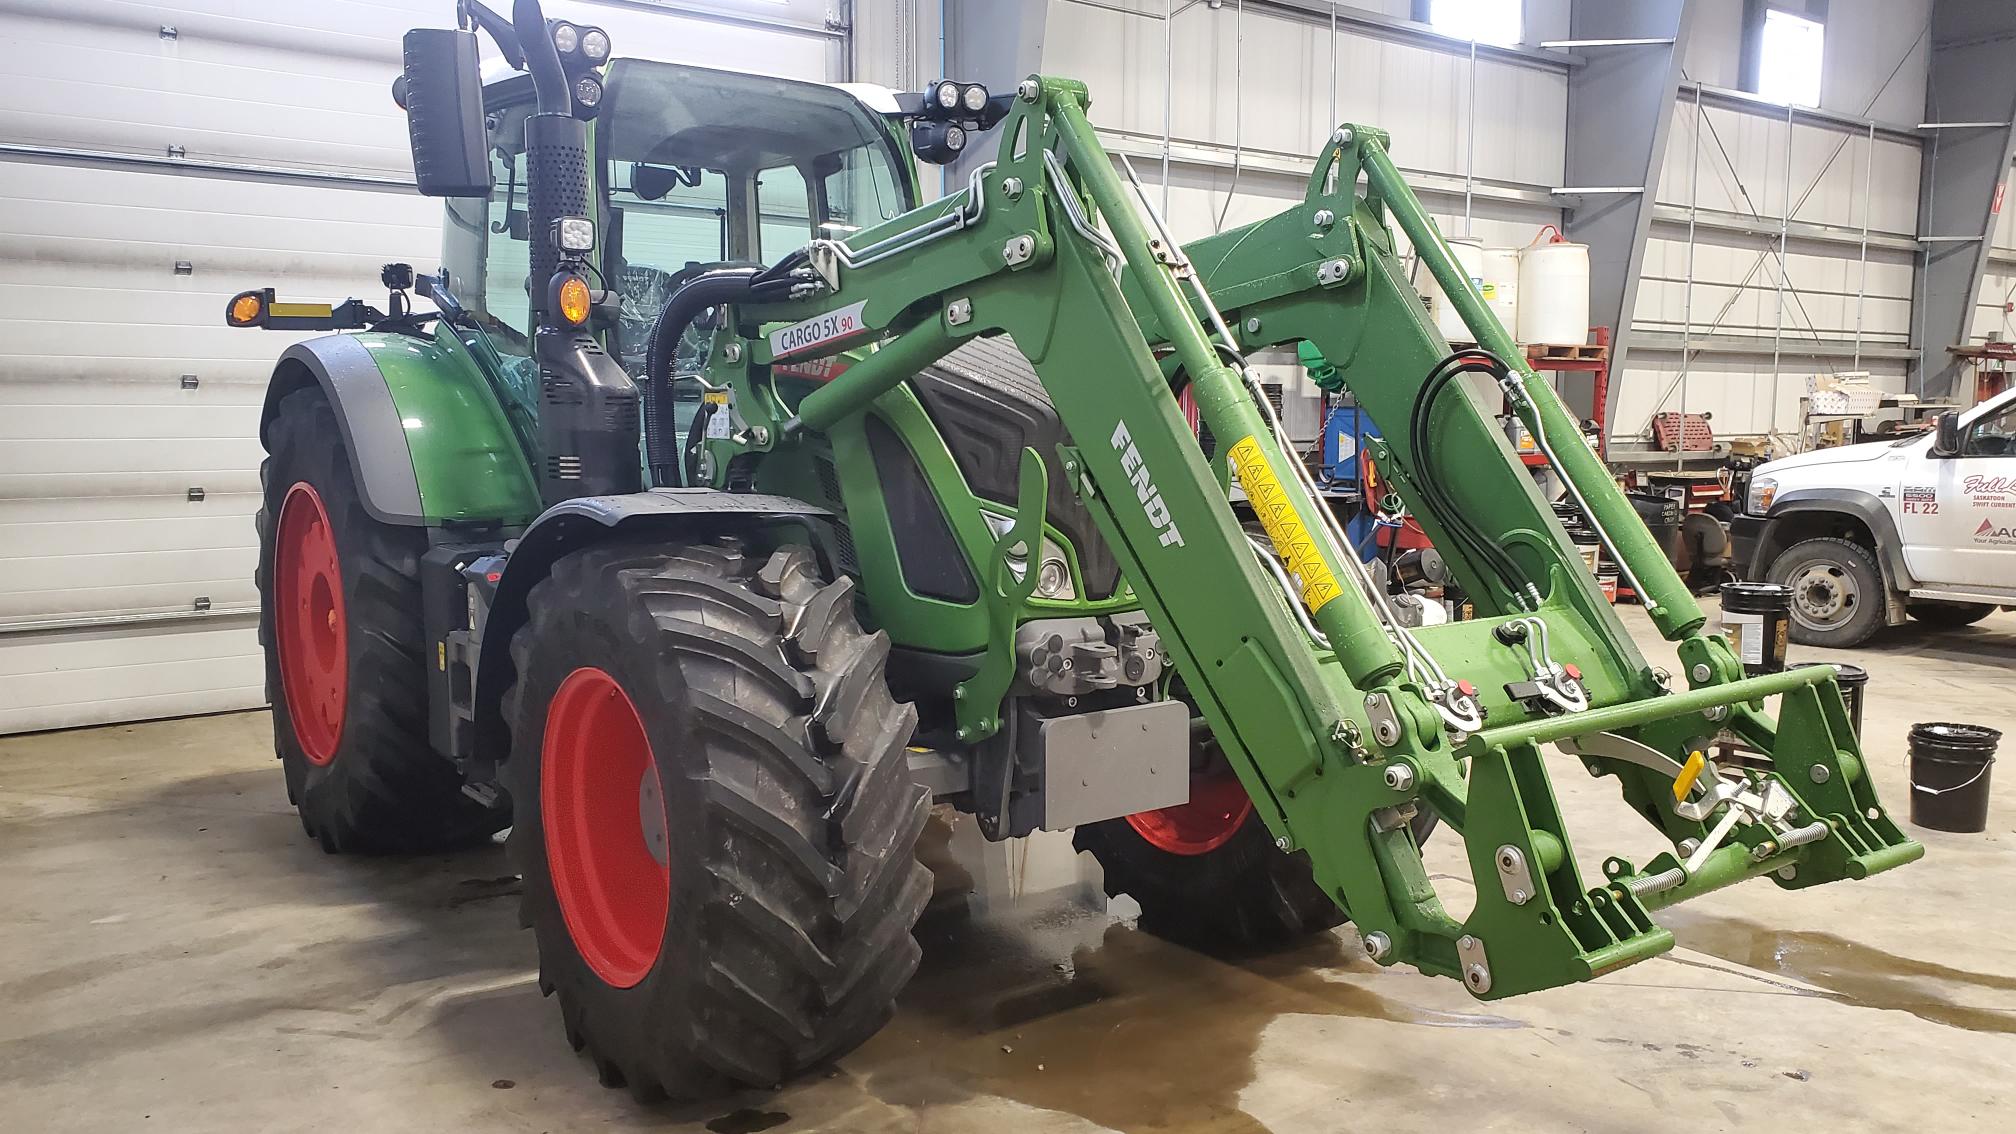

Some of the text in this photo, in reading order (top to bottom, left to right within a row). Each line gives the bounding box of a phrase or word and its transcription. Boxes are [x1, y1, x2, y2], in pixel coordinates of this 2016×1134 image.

[781, 315, 853, 350] CARGO 5X 90
[1110, 418, 1186, 548] FENDT
[1963, 474, 2007, 494] Full
[1903, 502, 1939, 514] FL 22
